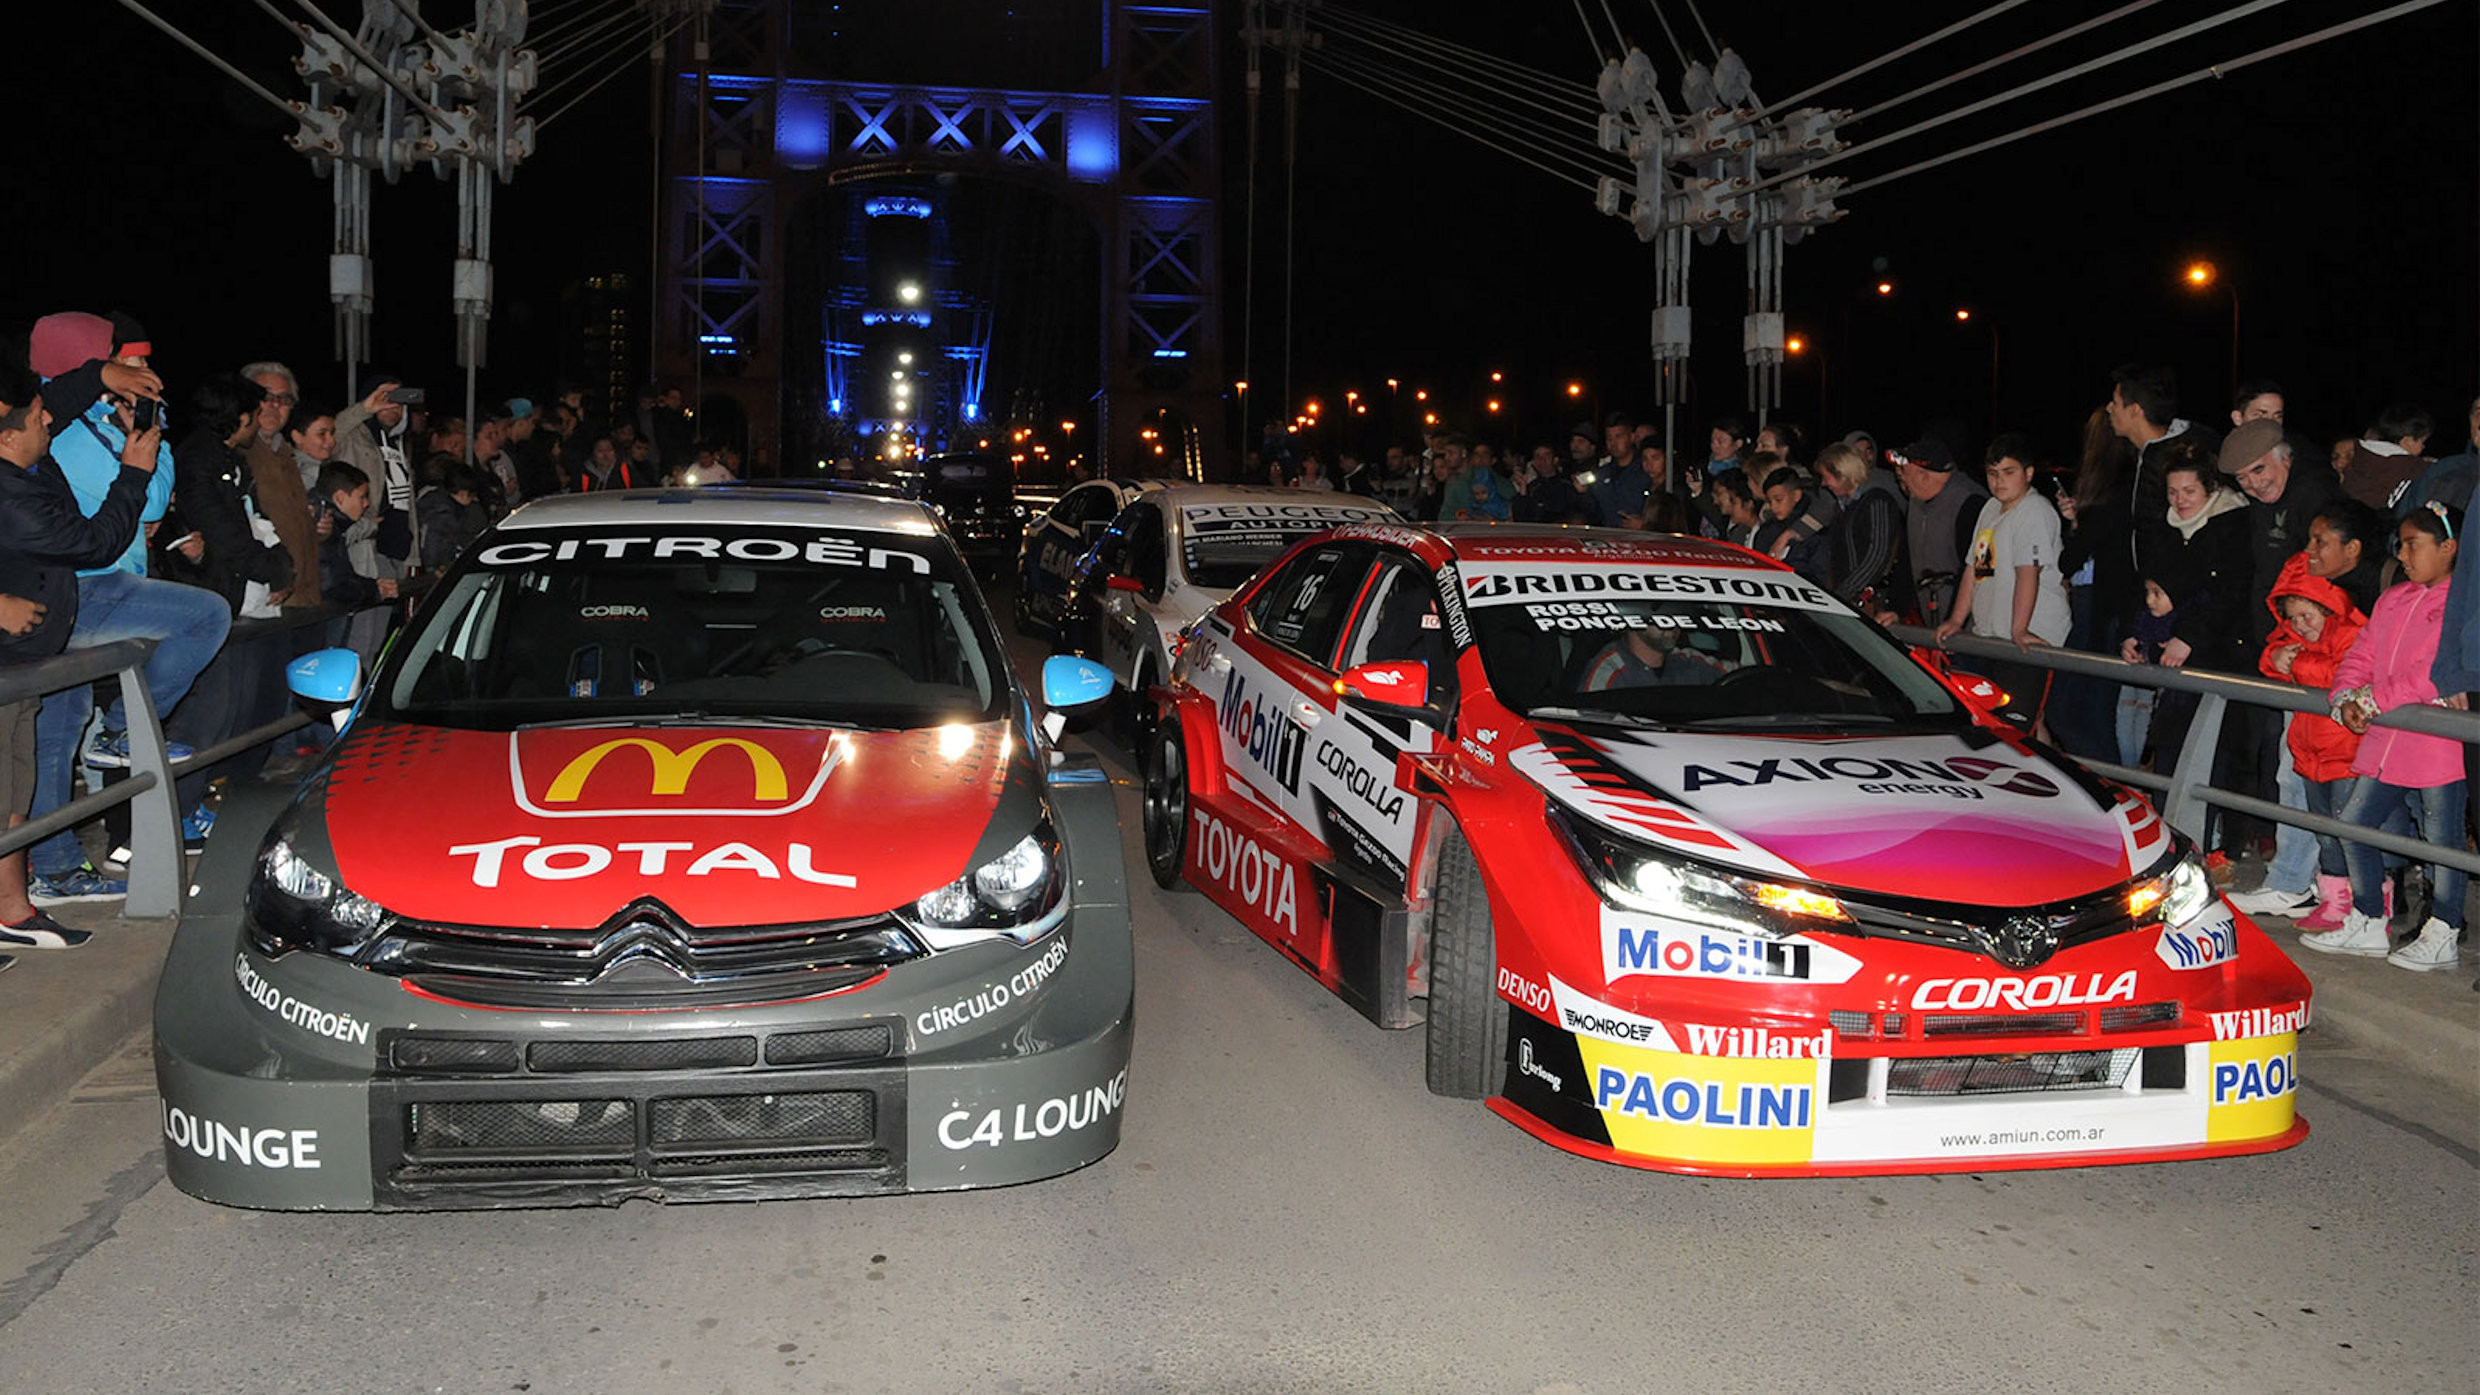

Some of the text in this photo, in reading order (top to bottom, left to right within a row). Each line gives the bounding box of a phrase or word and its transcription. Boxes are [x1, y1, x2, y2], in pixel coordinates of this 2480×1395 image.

[1186, 506, 1394, 523] PEUGEOT
[478, 537, 931, 574] CITROËN
[1473, 546, 1576, 555] TOYOTA
[1293, 575, 1324, 611] 16
[1467, 572, 1830, 607] BRIDGESTONE
[581, 605, 649, 617] COBRA
[820, 607, 886, 618] COBRA
[1438, 573, 1472, 649] PILKINGTON
[1524, 602, 1620, 618] ROSSI
[1535, 615, 1785, 633] PONCE DE LEON
[1317, 740, 1404, 825] COROLLA
[1684, 757, 1968, 792] AXION
[1858, 781, 1984, 800] energy
[449, 836, 856, 888] TOTAL
[1194, 808, 1297, 936] TOYOTA
[917, 935, 1069, 1035] CÍRCULO CITROËN
[1498, 966, 1551, 1013] DENSO
[1911, 970, 2138, 1011] COROLLA
[280, 997, 370, 1045] CITROËN
[1572, 1010, 1643, 1041] MONROE
[2210, 1001, 2306, 1041] Willard
[1685, 1024, 1833, 1059] Willard
[938, 1064, 1128, 1150] C4 LOUNG
[1599, 1067, 1811, 1128] PAOLINI
[161, 1097, 322, 1169] LOUNGE
[1941, 1126, 2105, 1148] www.amiun.com.ar
